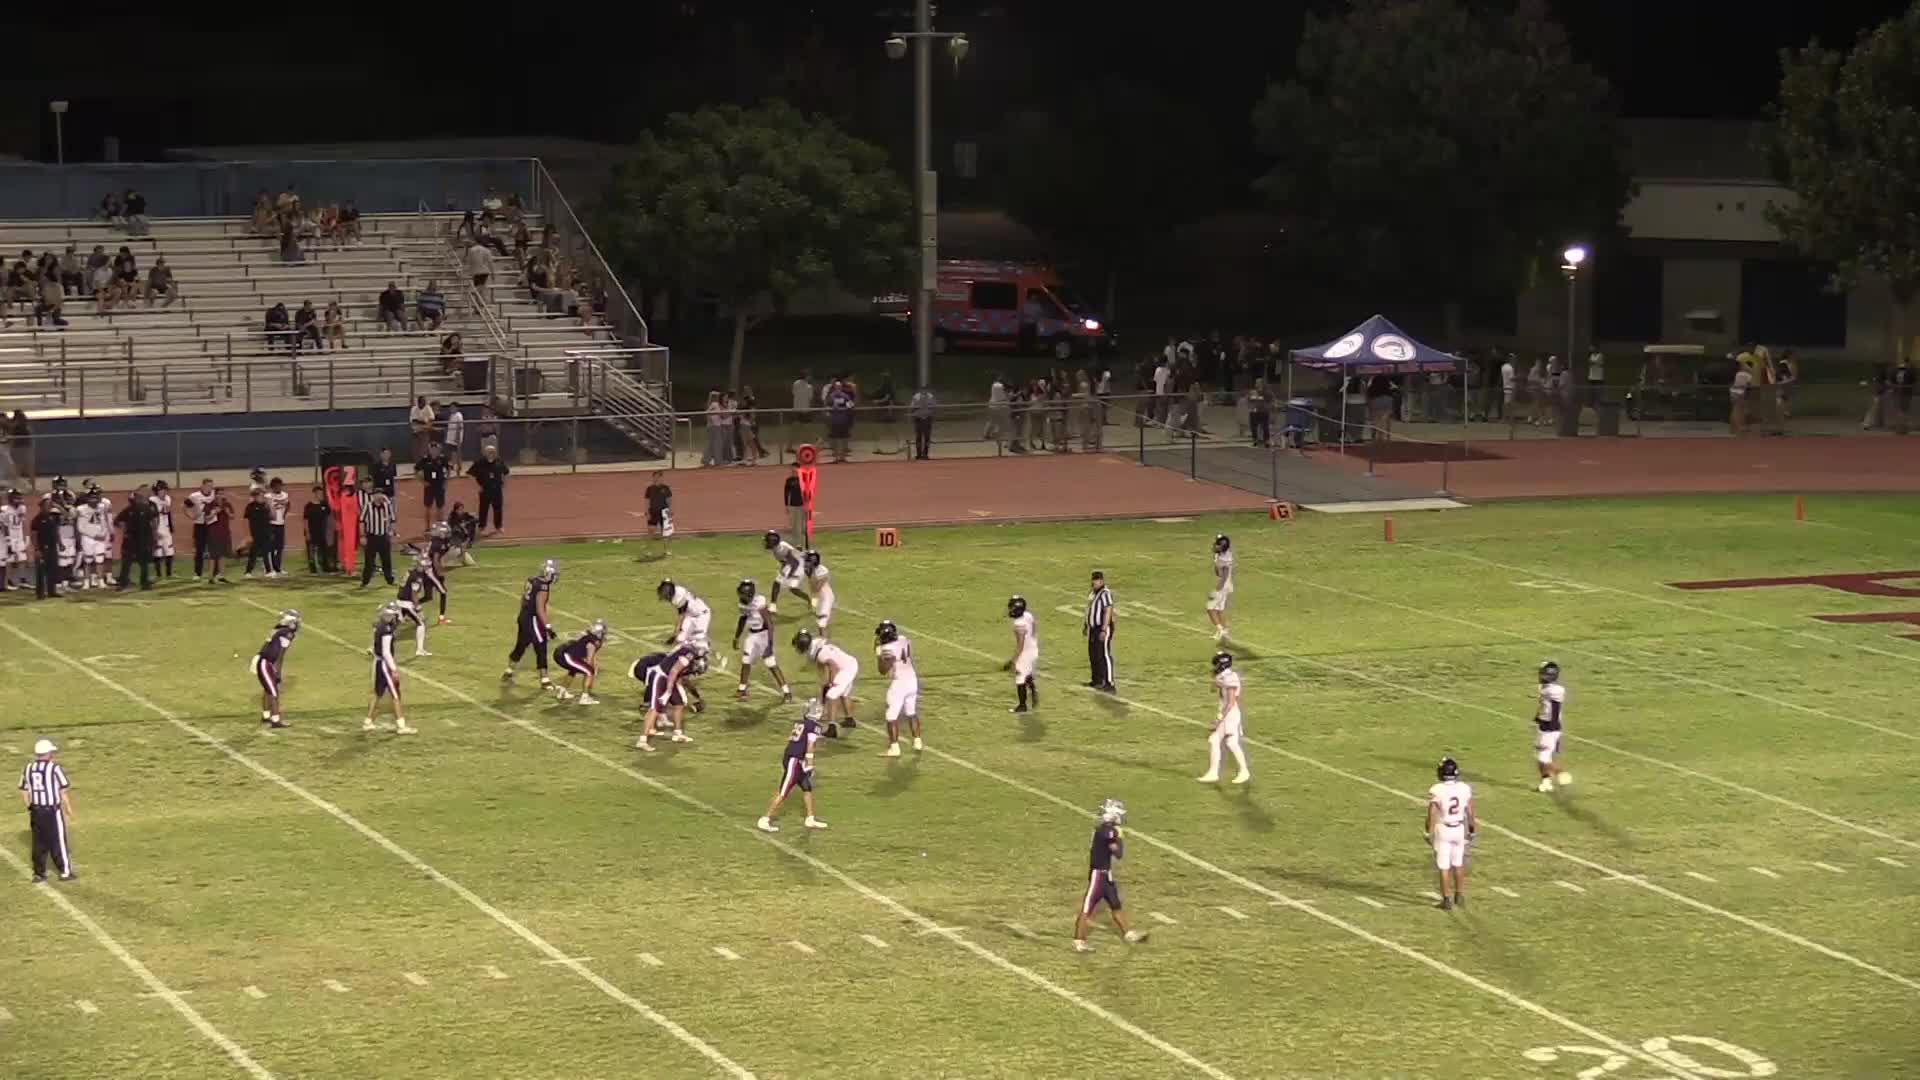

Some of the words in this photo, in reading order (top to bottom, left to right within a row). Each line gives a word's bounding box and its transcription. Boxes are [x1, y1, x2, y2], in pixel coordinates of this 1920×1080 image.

[879, 532, 895, 547] 10
[31, 772, 44, 791] R
[1448, 796, 1459, 815] 2
[1521, 1034, 1778, 1080] 20
